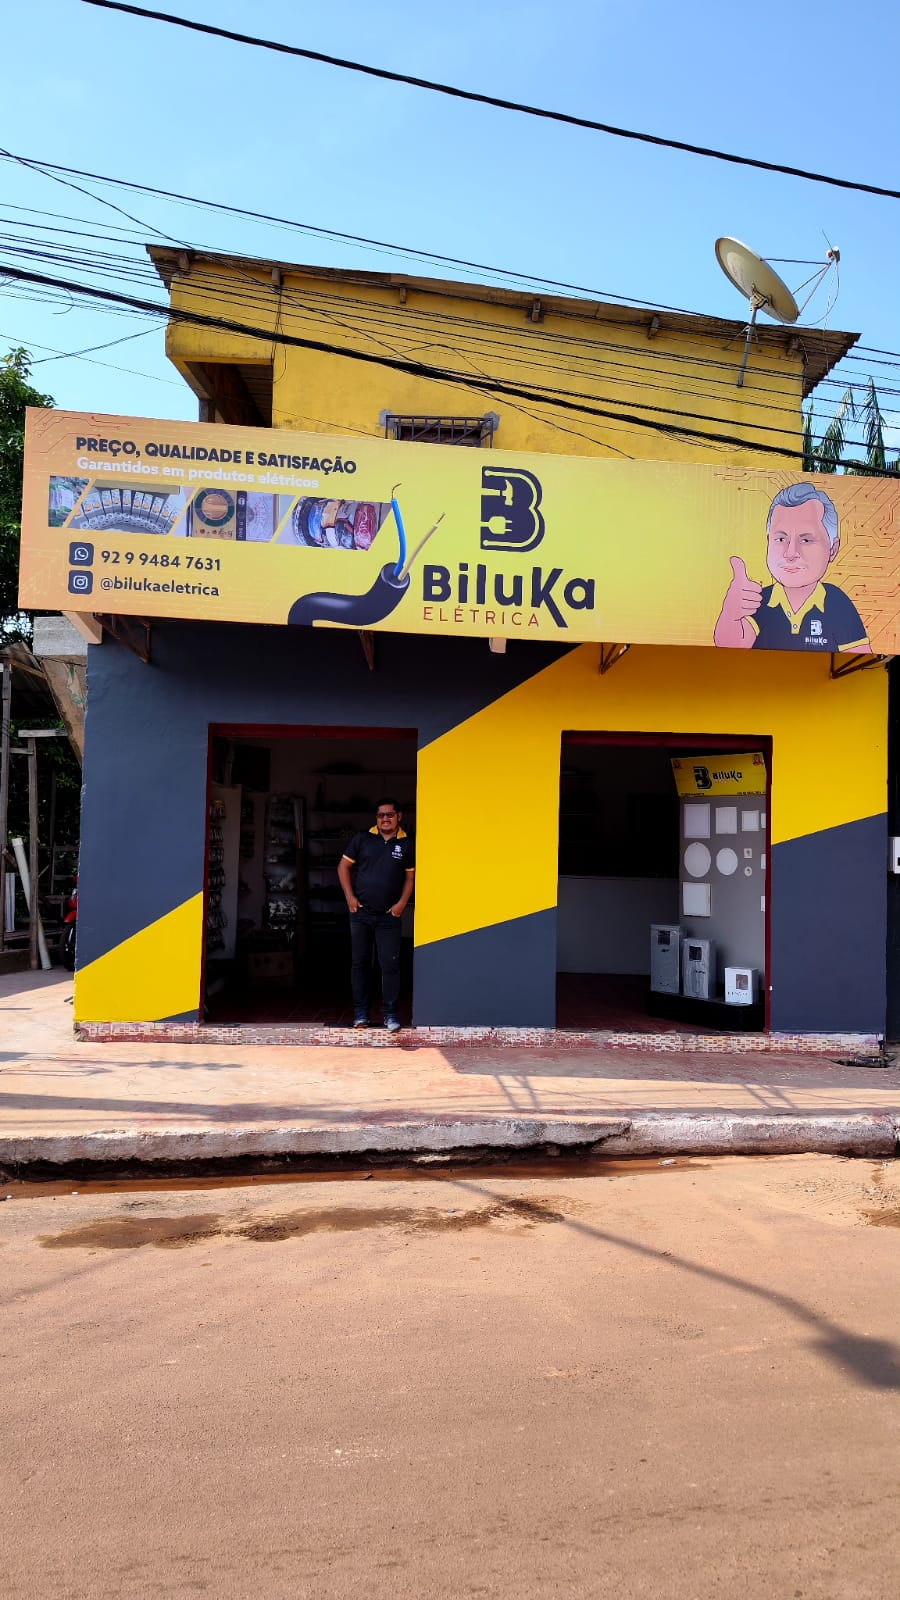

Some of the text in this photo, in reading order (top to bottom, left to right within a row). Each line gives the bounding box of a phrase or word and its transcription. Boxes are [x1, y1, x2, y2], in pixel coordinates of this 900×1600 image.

[76, 436, 357, 476] PREÇO, QUALIDADE E SATISFAÇÃO
[77, 456, 320, 489] Garantidos em produtos elétricos
[101, 550, 221, 571] 92 9 9484 7631
[100, 576, 220, 597] @bilukaeletrica
[423, 605, 540, 627] ELÉTRICA
